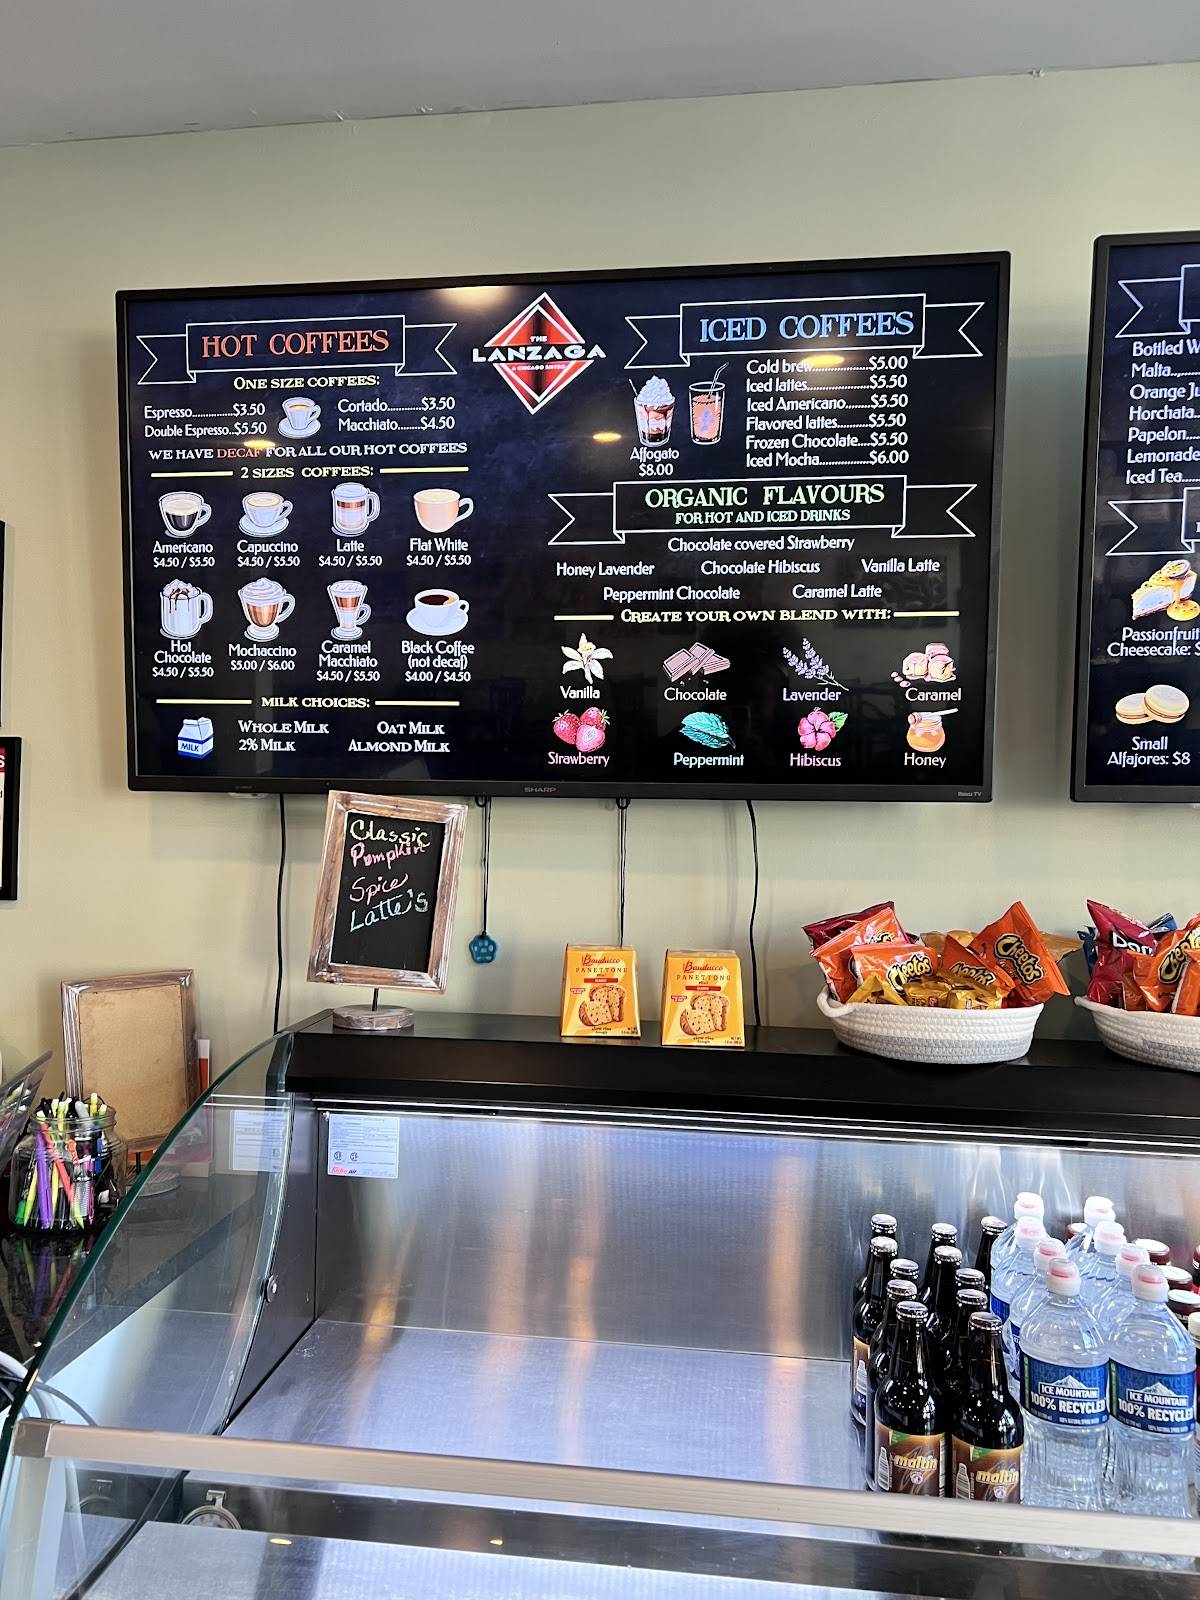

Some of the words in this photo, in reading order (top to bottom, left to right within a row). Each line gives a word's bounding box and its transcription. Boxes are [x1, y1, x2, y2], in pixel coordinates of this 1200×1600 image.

[700, 317, 767, 343] ICED
[779, 311, 914, 339] COFFEES
[202, 335, 257, 358] HOT
[269, 330, 389, 355] COFFEES
[1133, 339, 1183, 356] Bottled
[473, 344, 607, 362] LANZAGA
[747, 359, 779, 375] Cold
[233, 376, 267, 390] ONE
[271, 377, 304, 388] SIZE
[307, 375, 379, 387] COFFEES:
[746, 378, 772, 393] Iced
[1130, 384, 1186, 401] Orange
[747, 397, 774, 412] Iced
[746, 416, 802, 431] Flavored
[145, 425, 183, 438] Double
[746, 436, 790, 449] Frozen
[149, 450, 173, 460] WE
[175, 449, 213, 459] HAVE
[217, 448, 261, 459] DECAF
[265, 447, 297, 458] FOR
[299, 446, 326, 457] ALL
[329, 445, 363, 457] OUR
[364, 444, 396, 455] HOT
[398, 443, 467, 455] COFFEES
[630, 447, 679, 462] Affogato
[746, 454, 772, 468] Iced
[241, 468, 249, 478] 2
[252, 467, 294, 478] SIZES
[302, 466, 374, 477] COFFEES:
[639, 464, 673, 477] $8.00
[645, 487, 748, 509] ORGANIC
[763, 484, 885, 505] FLAVOURS
[675, 512, 703, 525] FOR
[705, 511, 733, 523] HOT
[736, 510, 764, 522] AND
[766, 510, 797, 522] ICED
[800, 509, 850, 521] DRINKS
[153, 541, 213, 554] Americano
[237, 540, 298, 554] Capuccino
[336, 539, 365, 552] Latte
[410, 538, 432, 551] Flat
[434, 538, 469, 551] White
[668, 537, 733, 553] Chocolate
[734, 537, 784, 552] covered
[786, 536, 855, 552] Strawberry
[153, 556, 179, 568] $4.50
[190, 556, 215, 568] $5.50
[237, 556, 263, 568] $4.50
[274, 555, 300, 567] $5.50
[319, 555, 345, 567] $4.50
[355, 555, 382, 567] $5.50
[406, 554, 434, 566] $4.50
[444, 554, 471, 566] $5.50
[701, 561, 763, 575] Chocolate
[765, 560, 820, 575] Hibiscus
[861, 558, 905, 573] Vanilla
[907, 558, 940, 573] Latte
[556, 562, 595, 578] Honey
[598, 562, 655, 576] Lavender
[603, 587, 674, 603] Peppermint
[676, 586, 740, 600] Chocolate
[792, 584, 848, 599] Caramel
[850, 584, 882, 598] Latte
[620, 609, 682, 623] CREATE
[686, 609, 731, 622] YOUR
[733, 608, 775, 621] OWN
[779, 608, 837, 620] BLEND
[841, 607, 892, 620] WITH:
[171, 640, 191, 653] Hot
[228, 644, 296, 657] Mochaccino
[321, 641, 371, 654] Caramel
[402, 641, 433, 654] Black
[436, 641, 475, 656] Coffee
[1107, 640, 1191, 656] Cheesecake:
[154, 652, 211, 664] Chocolate
[319, 654, 378, 667] Macchiato
[408, 654, 430, 669] (not
[433, 654, 468, 669] decaf)
[152, 667, 178, 678] $4.50
[188, 666, 214, 678] $5.50
[231, 660, 257, 672] $5.00
[268, 660, 295, 672] $6.00
[317, 671, 343, 683] $4.50
[354, 671, 380, 683] $5.50
[405, 671, 433, 683] $4.00
[443, 671, 471, 683] $4.50
[560, 686, 600, 699] Vanilla
[664, 687, 727, 701] Chocolate
[783, 687, 842, 701] Lavender
[905, 687, 962, 701] Caramel
[261, 698, 298, 707] MILK
[302, 697, 370, 708] CHOICES:
[181, 742, 199, 752] MILK
[239, 739, 258, 751] 2%
[1132, 736, 1168, 750] Small
[547, 752, 609, 768] Strawberry
[673, 753, 744, 769] Peppermint
[789, 753, 841, 767] Hibiscus
[904, 753, 946, 769] Honey
[1107, 752, 1169, 767] Alfajores:
[1172, 752, 1191, 765] $8
[350, 819, 430, 847] Classic
[351, 842, 425, 870] Pumpkin
[350, 873, 408, 905] Spice
[350, 889, 428, 932] Latte's
[582, 953, 620, 966] Bauducco
[683, 960, 723, 973] Bauducco
[995, 934, 1043, 984] Cheetos
[888, 953, 931, 992] Cheetos
[1041, 1384, 1054, 1396] ICE
[1055, 1387, 1099, 1399] MOUNTAIN
[1129, 1391, 1143, 1402] ICE
[1144, 1394, 1188, 1407] MOUNTAIN
[1030, 1392, 1056, 1411] 100%
[1058, 1400, 1106, 1415] RECYCLED
[895, 1454, 938, 1470] maltin
[976, 1470, 1019, 1484] maltin
